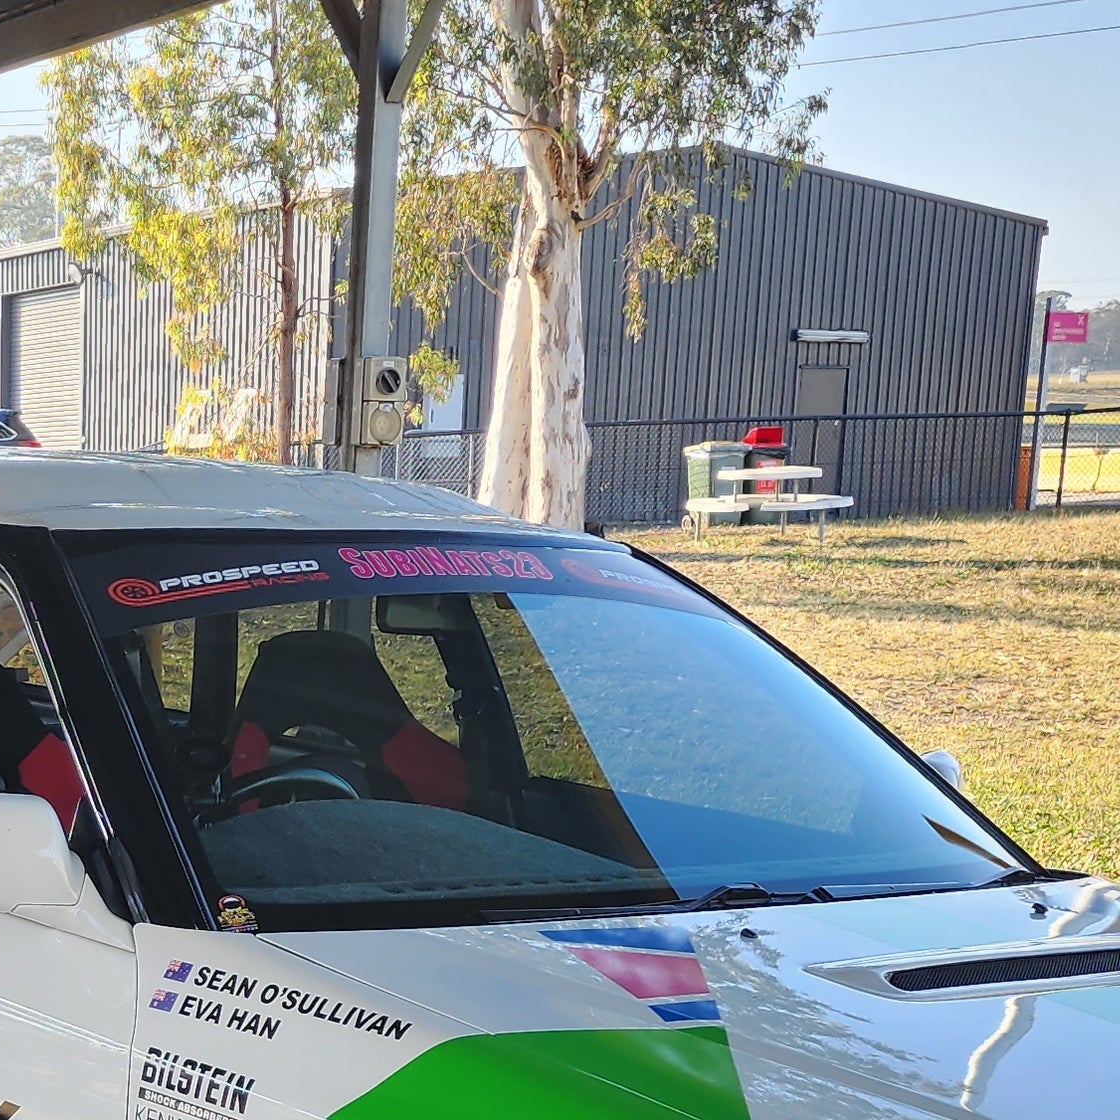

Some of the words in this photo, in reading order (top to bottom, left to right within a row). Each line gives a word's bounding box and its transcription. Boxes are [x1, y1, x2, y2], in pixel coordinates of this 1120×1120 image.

[159, 560, 320, 591] PROSPEED
[251, 572, 330, 588] RACING
[179, 995, 223, 1025] EVA
[229, 1008, 281, 1040] HAN
[194, 966, 258, 1000] SEAN
[260, 983, 412, 1041] O'SULLIVAN
[141, 1046, 256, 1115] BILSTEIN
[144, 1089, 177, 1109] SHOCK
